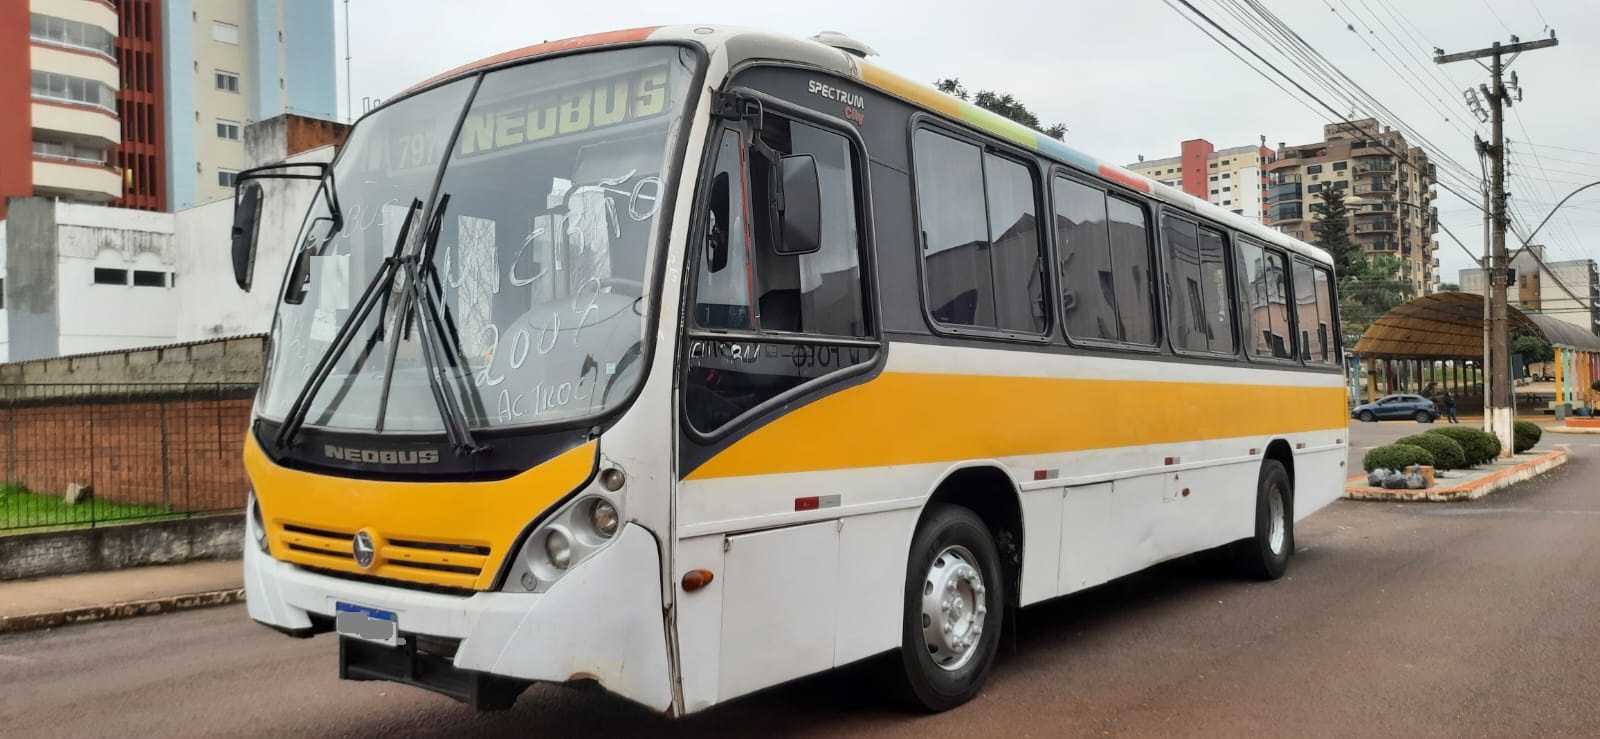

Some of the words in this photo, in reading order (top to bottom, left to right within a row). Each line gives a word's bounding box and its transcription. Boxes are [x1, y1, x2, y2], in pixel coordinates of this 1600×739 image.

[807, 79, 865, 110] SPECTRUM
[460, 69, 668, 156] NEOBUS
[324, 444, 440, 465] NEOBUS
